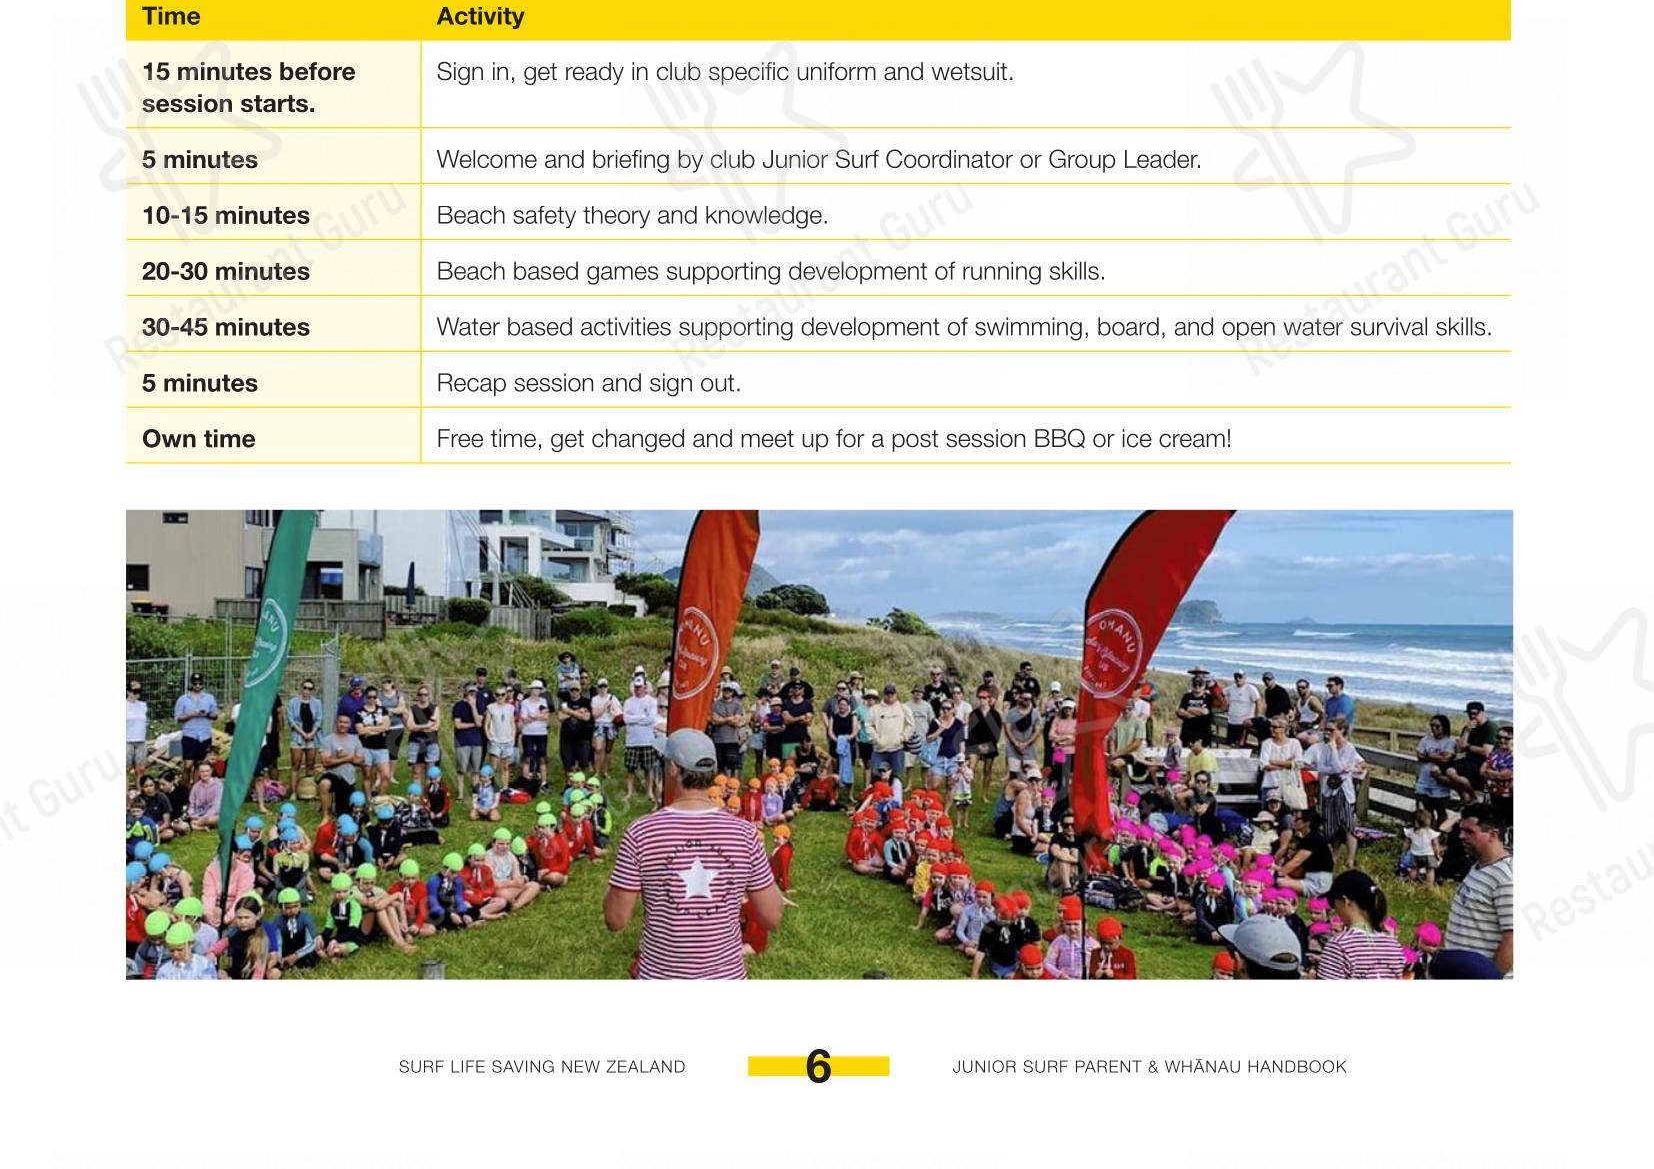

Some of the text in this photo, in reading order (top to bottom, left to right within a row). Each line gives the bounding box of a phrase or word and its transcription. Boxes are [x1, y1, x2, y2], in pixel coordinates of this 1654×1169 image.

[141, 5, 201, 26] Time
[436, 6, 525, 30] Activity
[143, 61, 356, 81] 15 minutes before
[437, 61, 1013, 86] Sign in, get ready in club specific uniform and wetsuit.
[142, 93, 315, 113] session starts.
[142, 149, 259, 169] 5 minutes
[143, 205, 310, 225] 10-15 minutes
[438, 205, 828, 230] Beach safety theory and knowledge.
[142, 261, 310, 281] 20-30 minutes
[438, 261, 1105, 286] Beach based games supporting development of running skills.
[142, 317, 310, 337] 30-45 minutes
[436, 316, 1492, 341] Water based activities supporting development of swimming, board, and open water survival skills.
[142, 373, 258, 393] 5 minutes
[142, 428, 256, 449] Own time
[399, 1059, 686, 1074] SURF LIFE SAVING NEW ZEALAND
[806, 1048, 832, 1084] 6
[952, 1056, 1347, 1074] JUNIOR SURF PARENT & WHĀNAU HANDBOOK
